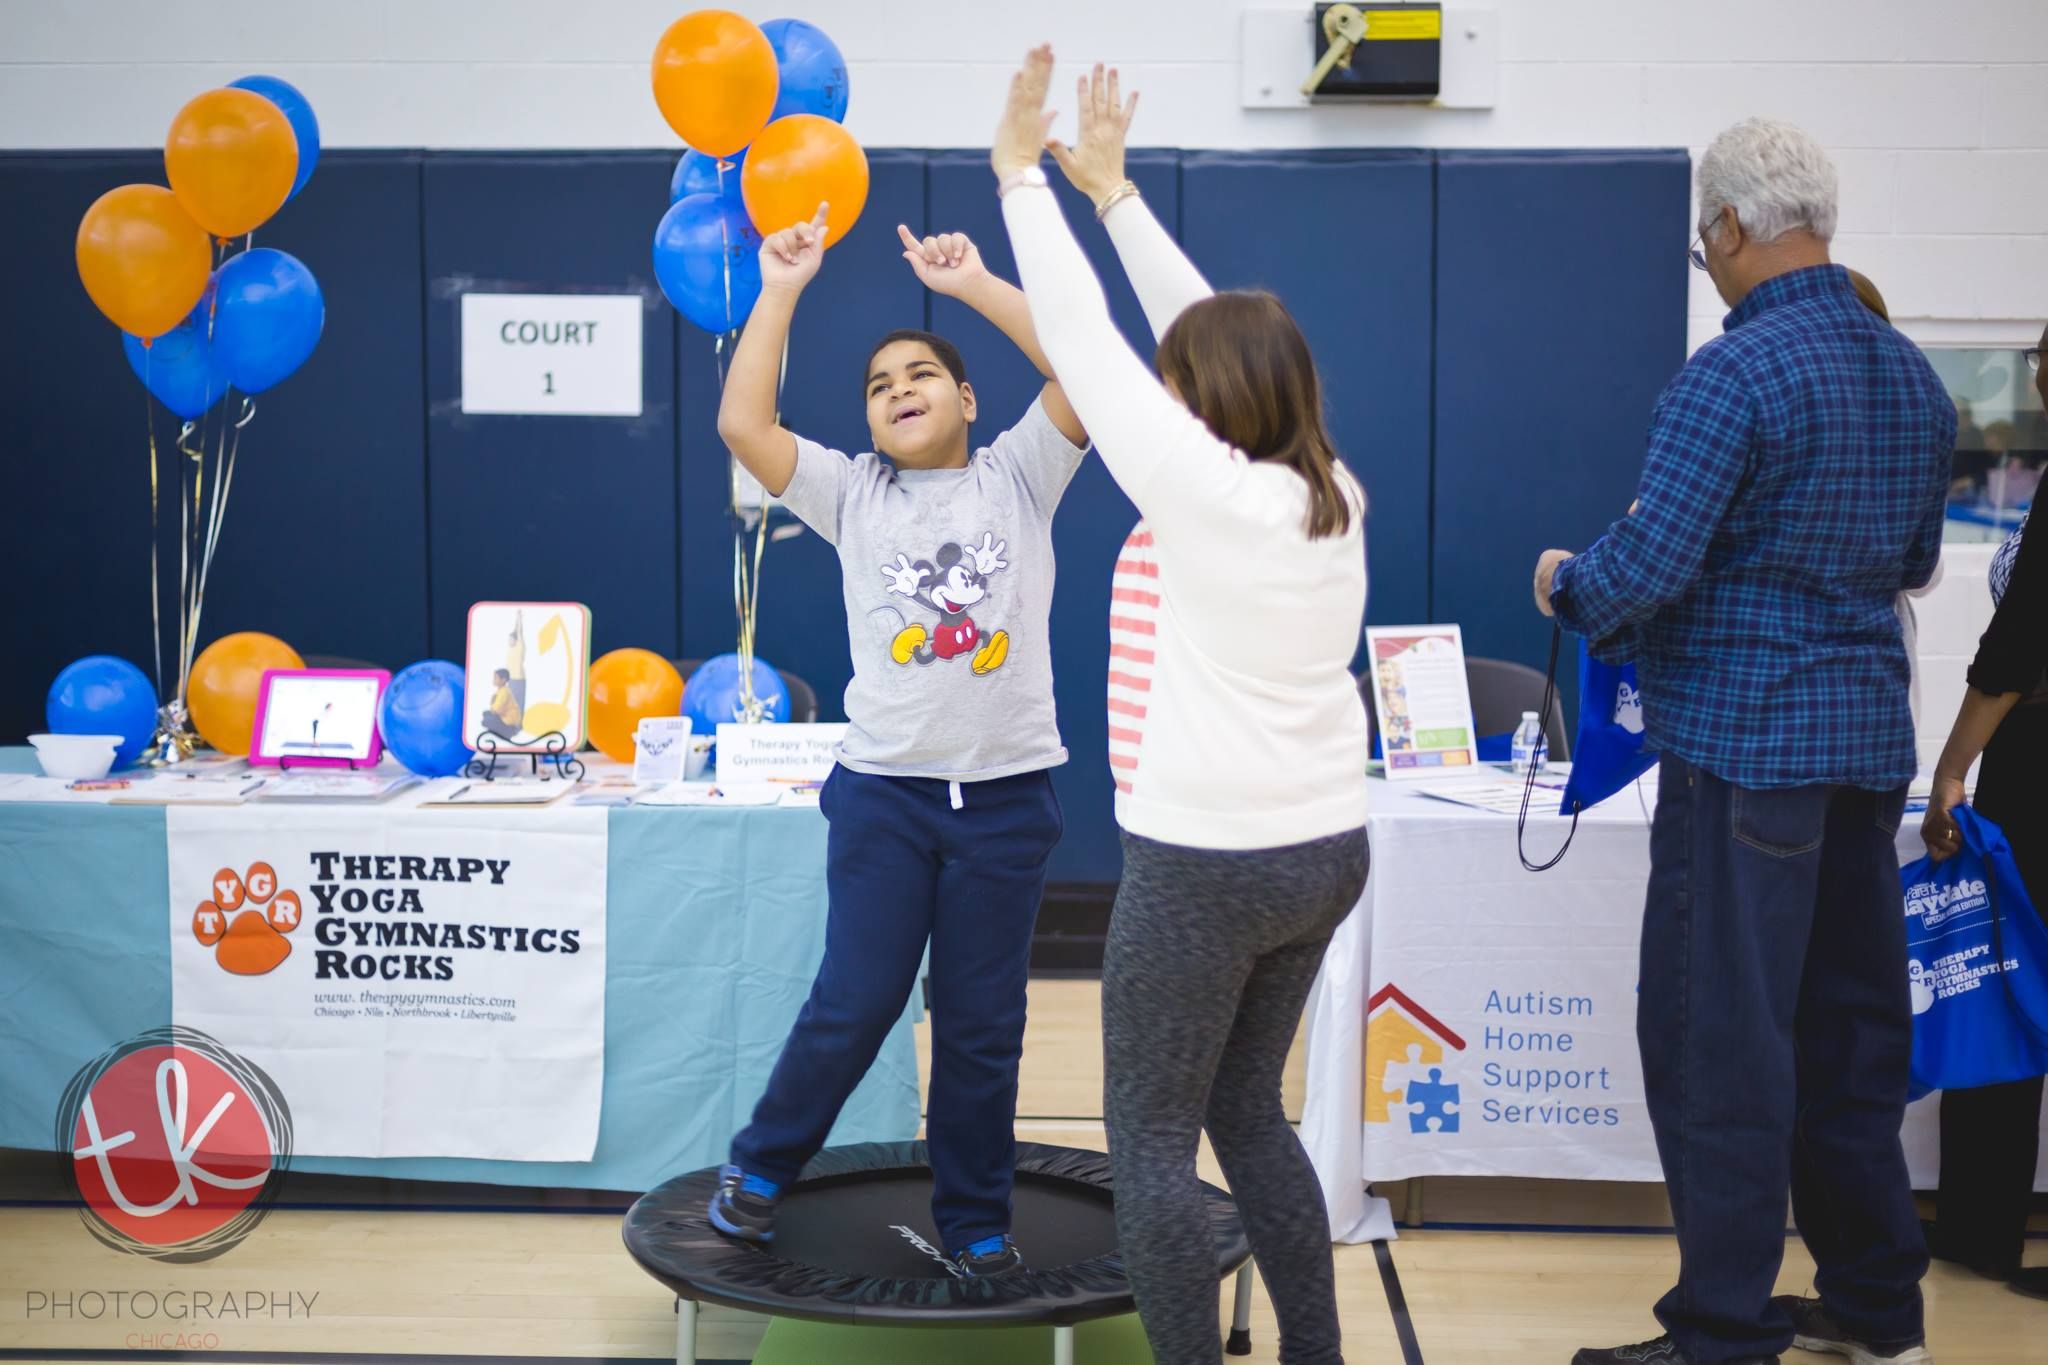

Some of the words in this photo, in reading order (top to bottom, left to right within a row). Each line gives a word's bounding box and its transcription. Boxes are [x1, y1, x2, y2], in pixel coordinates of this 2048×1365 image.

[500, 321, 597, 344] COURT
[542, 372, 555, 394] 1
[751, 738, 801, 750] Therapy
[732, 754, 808, 767] Gymnastics
[310, 852, 511, 885] THERAPY
[310, 885, 424, 914] YOGA
[1904, 880, 1987, 917] laydate
[1907, 881, 1939, 900] Parent
[315, 918, 580, 954] GYMNASTICS
[315, 950, 454, 981] ROCKS
[1932, 944, 1990, 970] THERAPY
[1934, 961, 1968, 979] YOGA
[1936, 959, 2019, 989] GYMNASTICS
[1938, 978, 1981, 1000] ROCKS
[314, 1006, 355, 1018] Chicago
[392, 1007, 451, 1019] Northbrook
[1485, 990, 1592, 1016] Autism
[1485, 1026, 1573, 1052] Home
[1483, 1062, 1610, 1093] Support
[1482, 1099, 1619, 1126] Services
